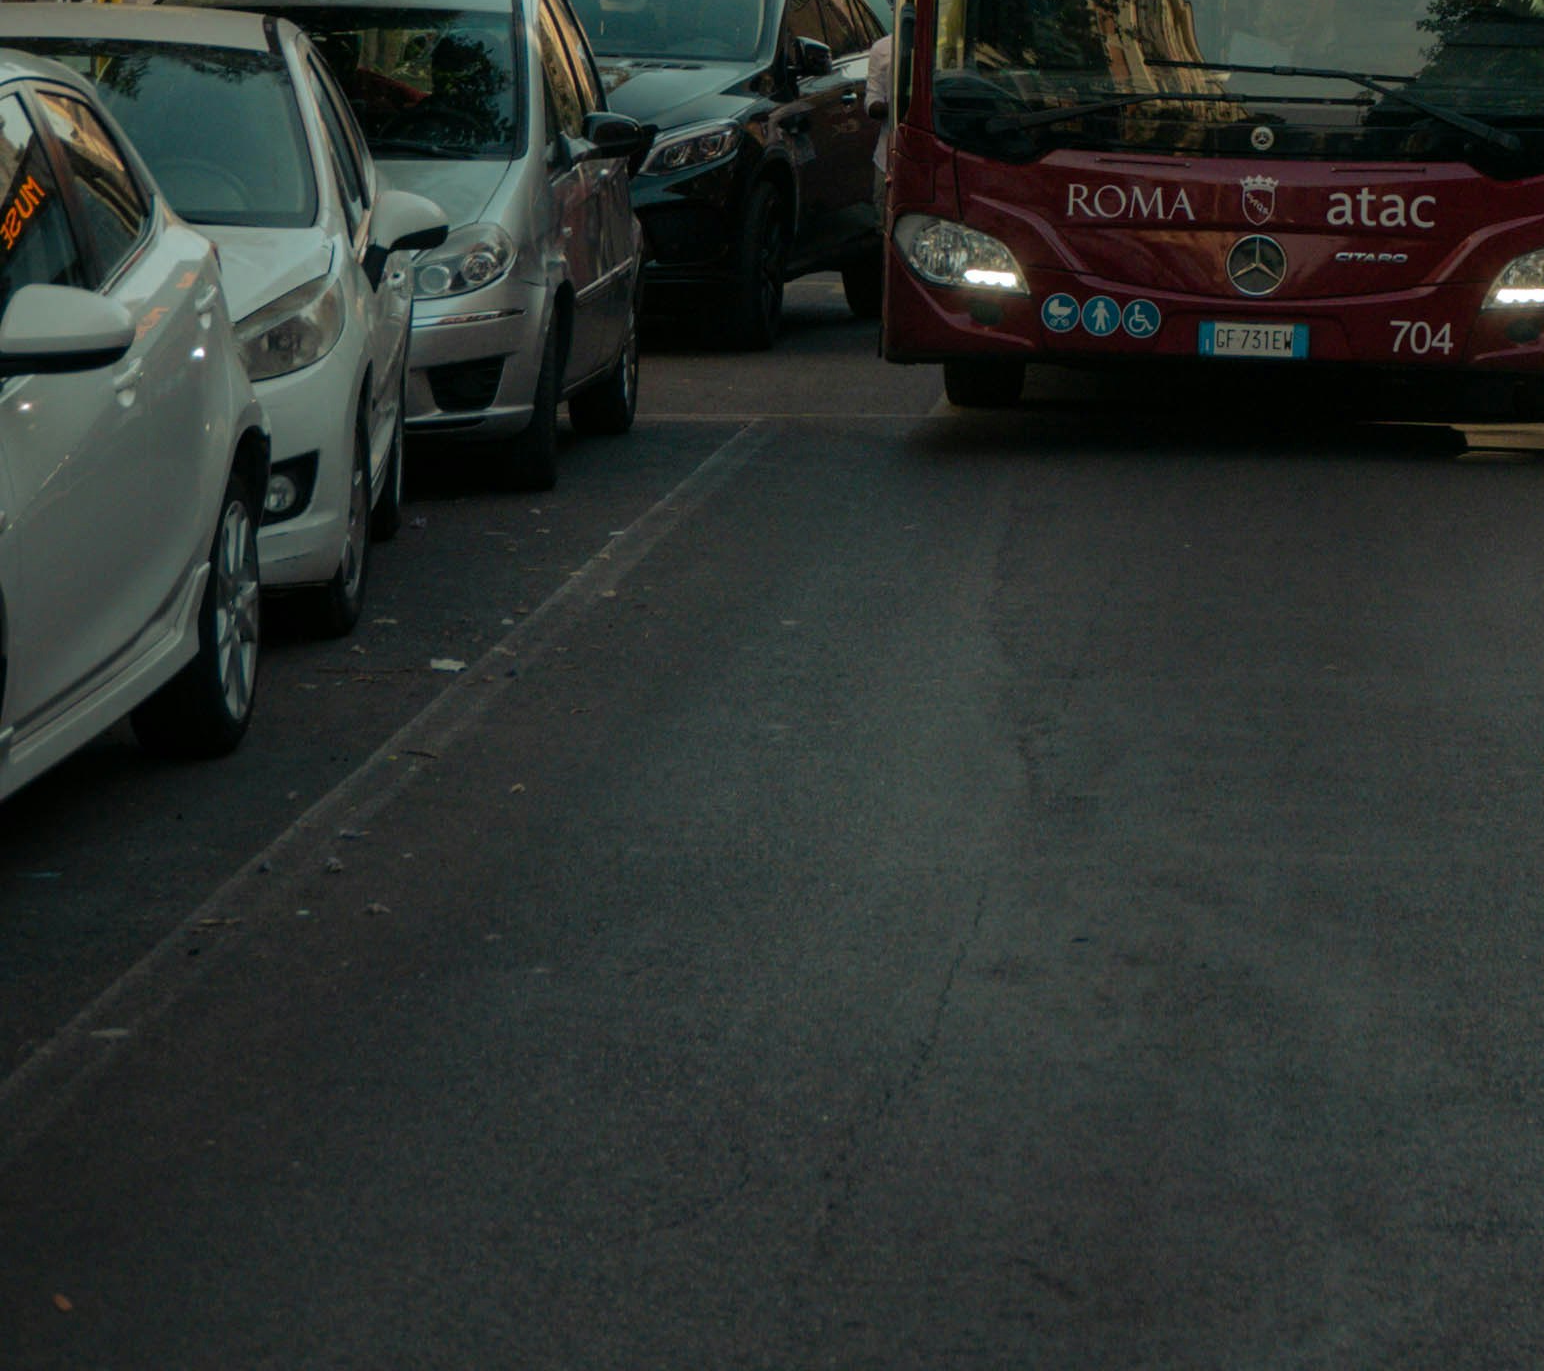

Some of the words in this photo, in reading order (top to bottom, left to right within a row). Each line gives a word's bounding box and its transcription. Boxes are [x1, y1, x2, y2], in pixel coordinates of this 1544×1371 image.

[1066, 183, 1197, 221] ROMA
[1326, 187, 1436, 229] atac
[1335, 251, 1408, 264] CITARO
[1389, 320, 1454, 356] 704
